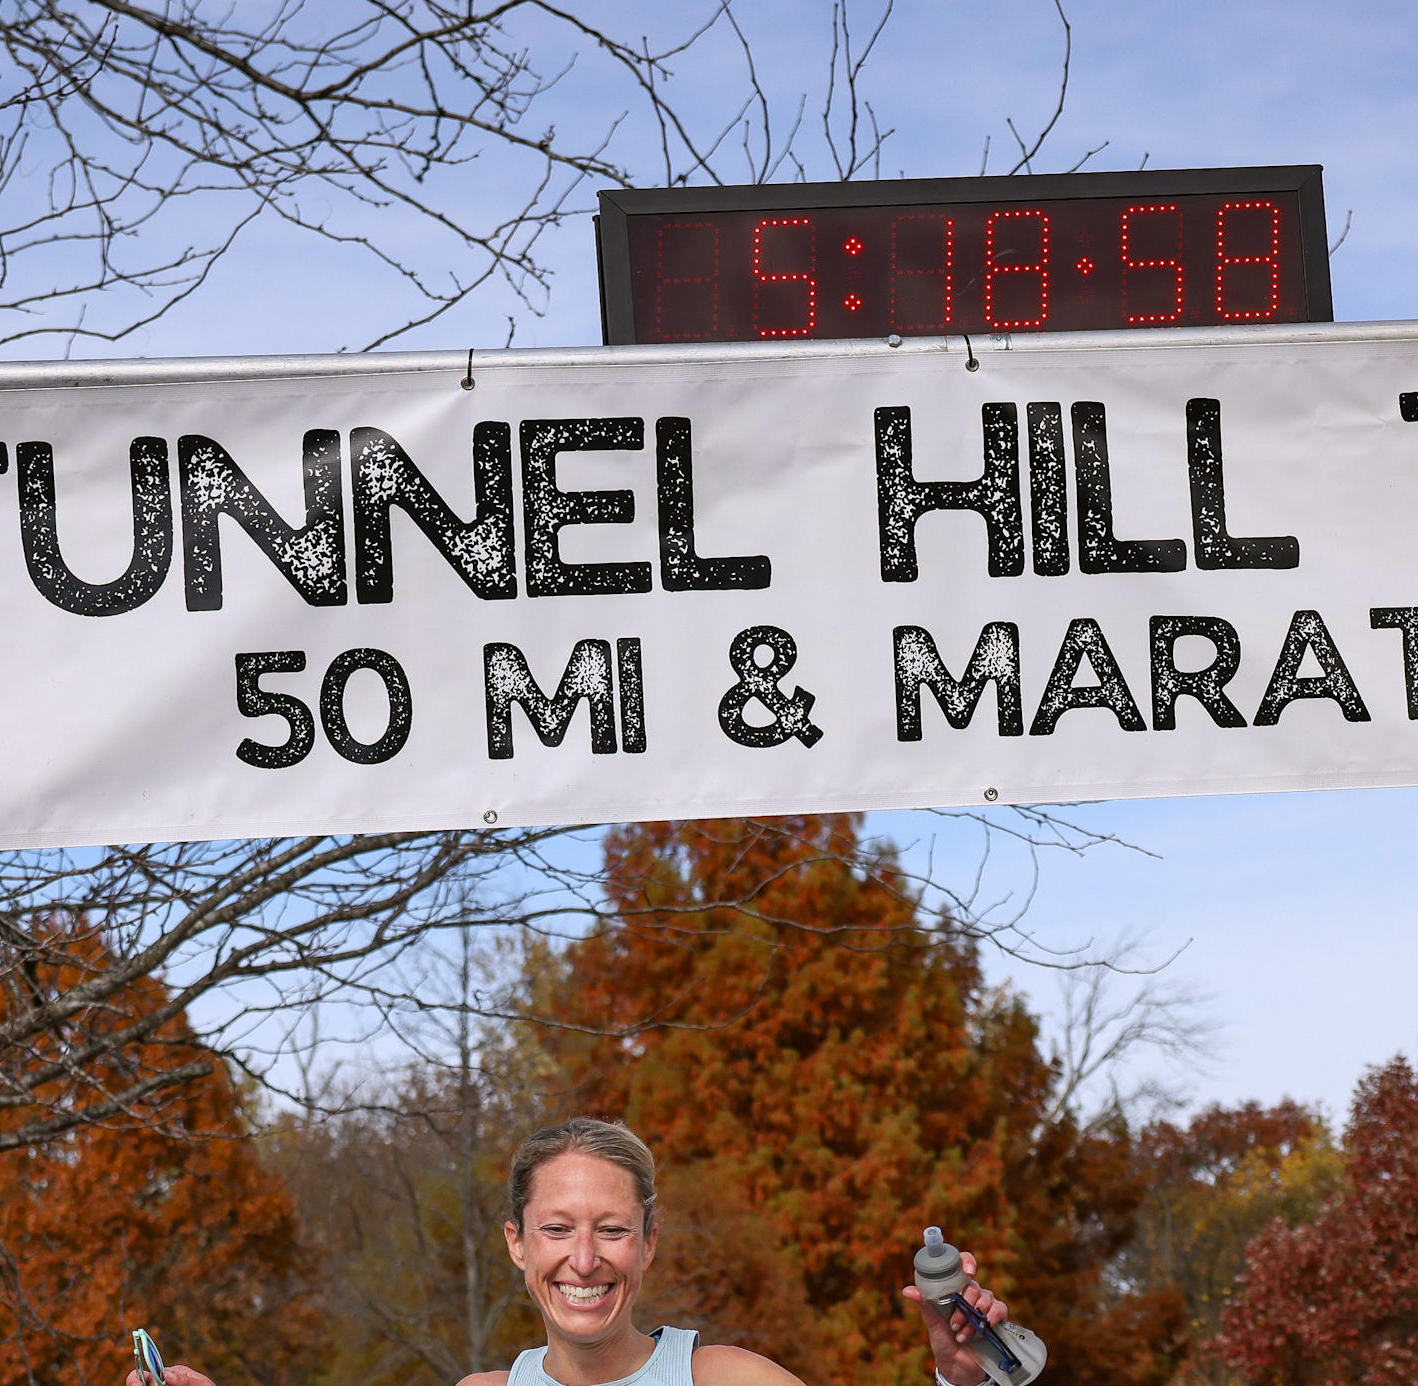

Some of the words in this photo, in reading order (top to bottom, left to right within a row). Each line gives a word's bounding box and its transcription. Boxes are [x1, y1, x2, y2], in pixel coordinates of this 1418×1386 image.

[873, 396, 1301, 582] HILL
[234, 646, 413, 769] 50
[484, 637, 649, 761] MI
[717, 625, 824, 749] &
